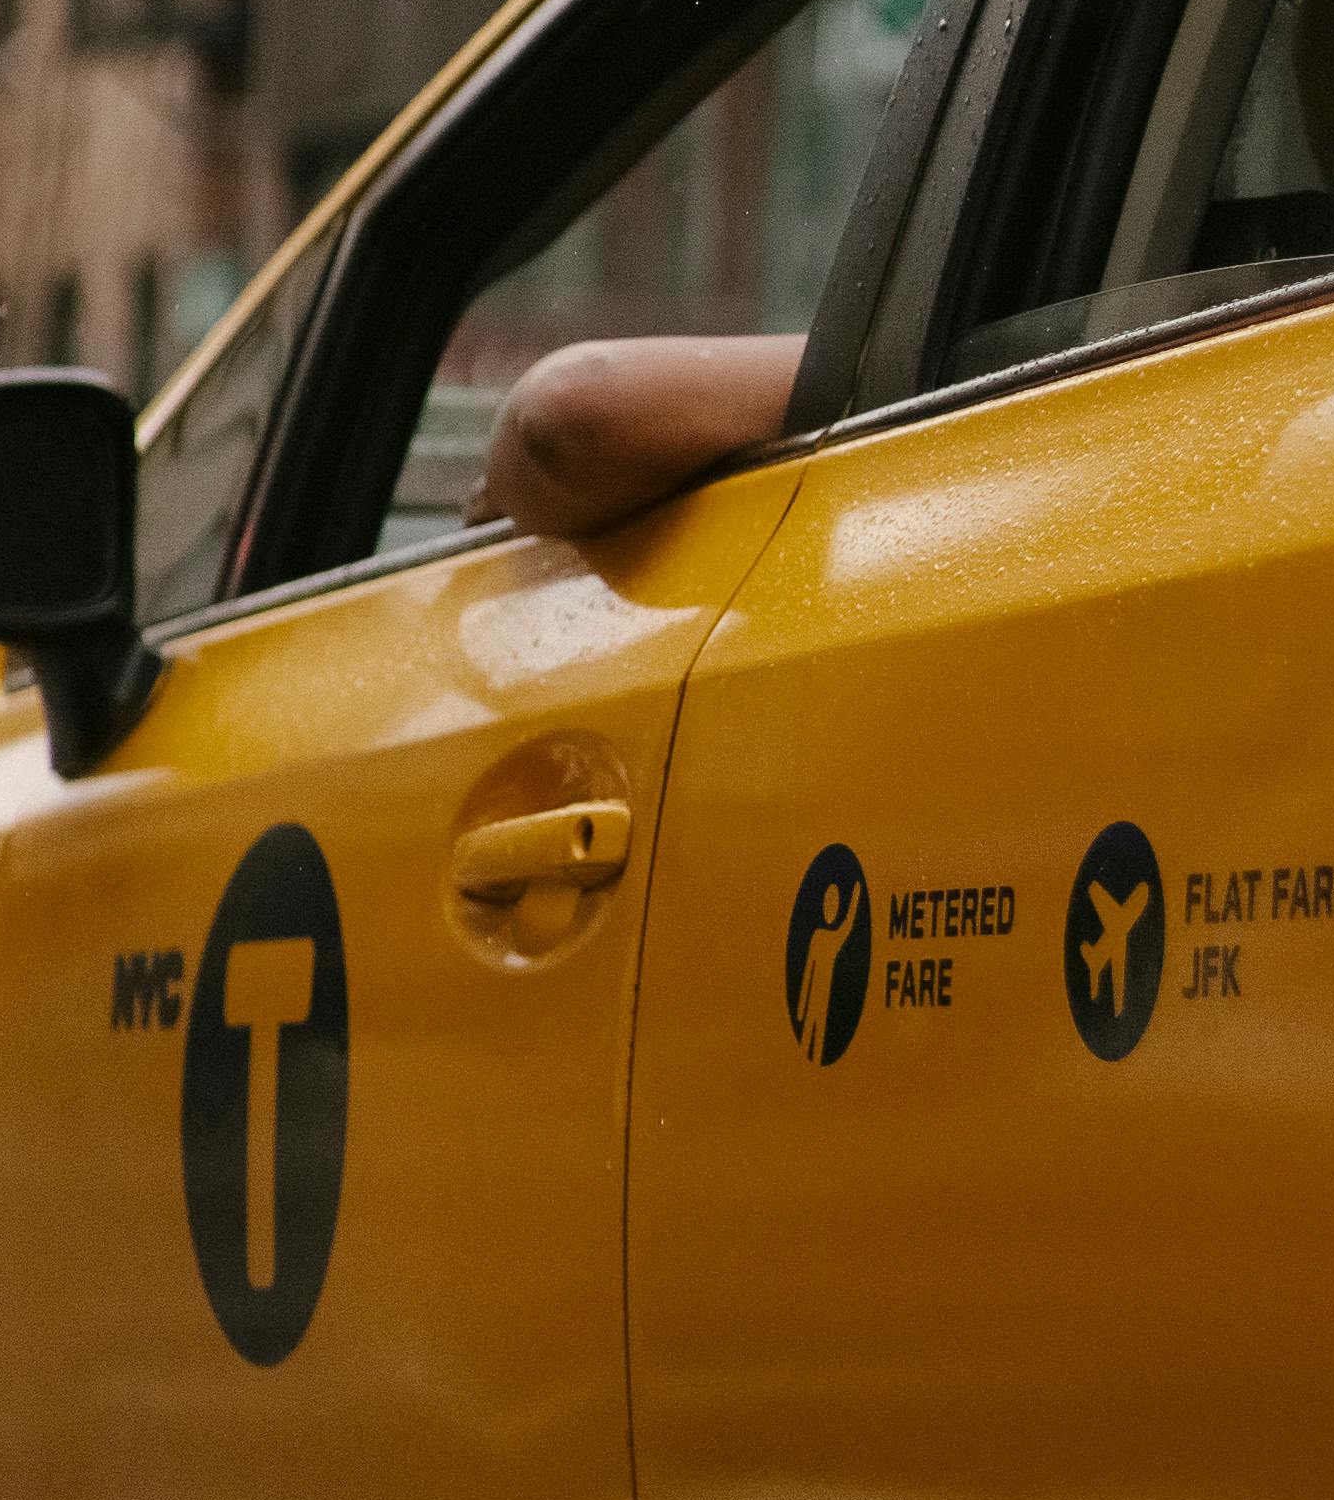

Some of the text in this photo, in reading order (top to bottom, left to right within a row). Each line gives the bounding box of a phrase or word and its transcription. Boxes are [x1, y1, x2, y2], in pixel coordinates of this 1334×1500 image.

[888, 886, 1015, 940] METERED
[1184, 869, 1263, 925] FLAT
[884, 958, 954, 1009] FARE
[1182, 945, 1243, 1001] JFK
[111, 937, 316, 1289] NYC T
